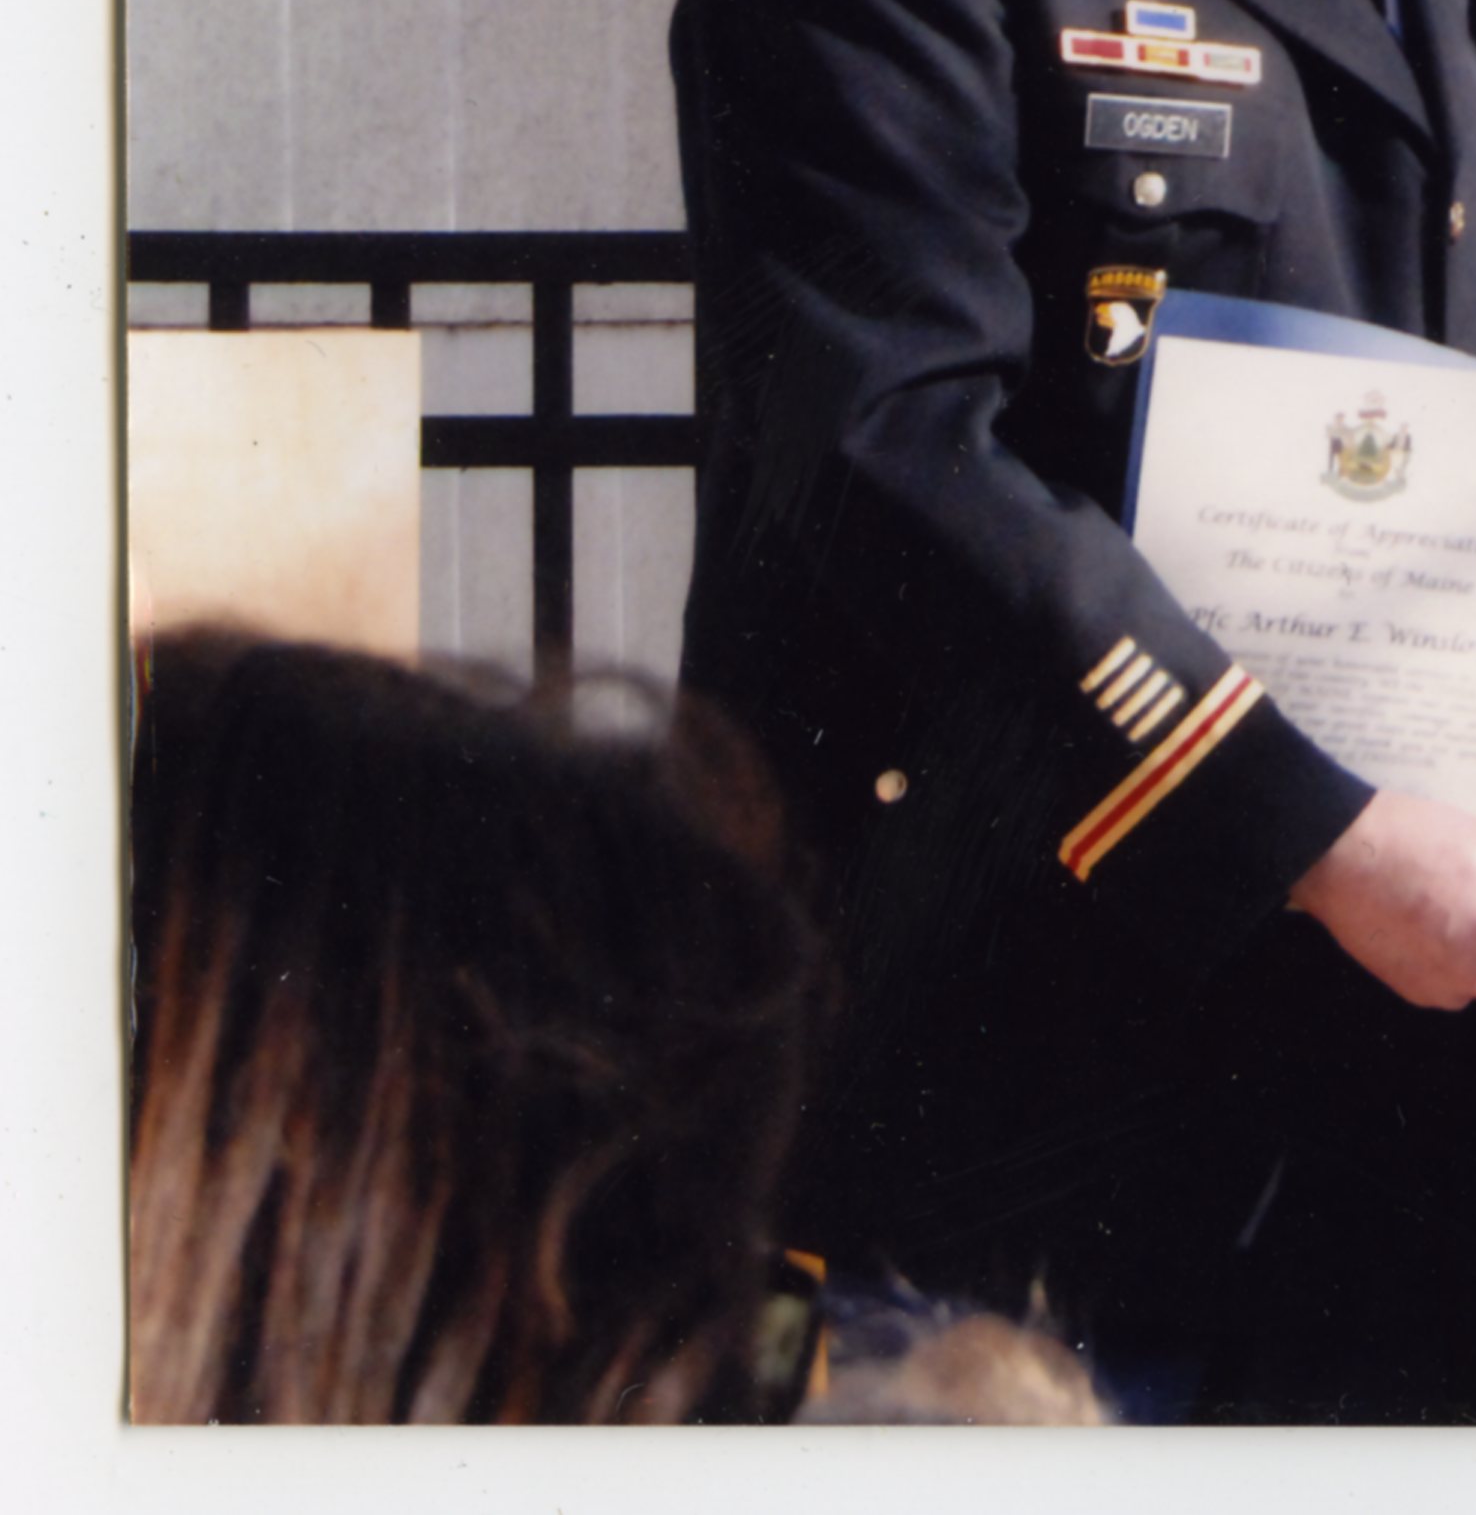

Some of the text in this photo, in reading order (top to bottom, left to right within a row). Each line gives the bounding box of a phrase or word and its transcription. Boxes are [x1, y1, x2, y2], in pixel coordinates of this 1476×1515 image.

[1122, 111, 1199, 142] OGDEN
[1197, 505, 1320, 534] Certificate
[1327, 515, 1348, 538] of
[1226, 548, 1265, 571] The
[1370, 565, 1396, 591] of
[1402, 569, 1476, 595] Maine
[1240, 611, 1339, 639] Arthur
